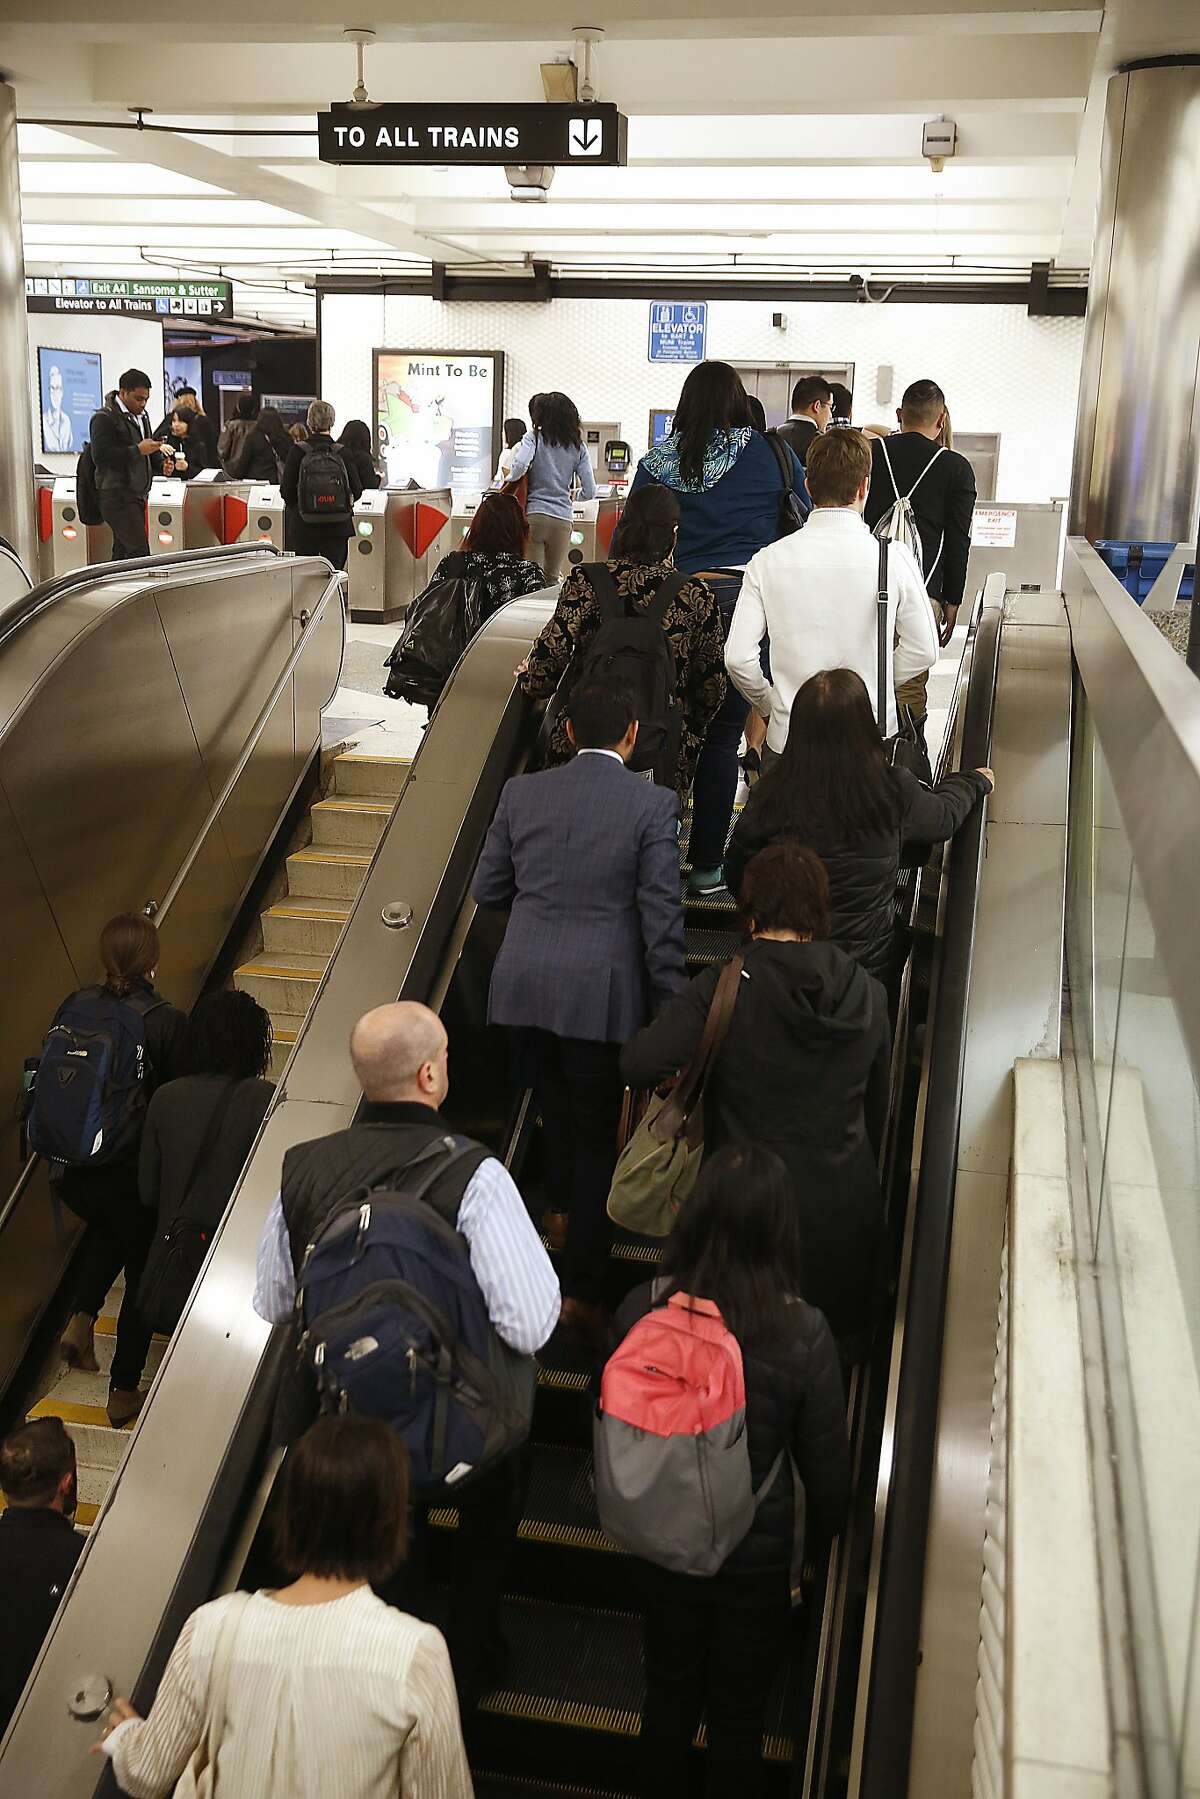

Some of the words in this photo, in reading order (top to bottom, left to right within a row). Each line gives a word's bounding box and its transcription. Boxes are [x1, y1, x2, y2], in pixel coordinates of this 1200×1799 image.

[333, 127, 365, 147] TO
[376, 127, 419, 147] ALL
[428, 127, 519, 148] TRAINS
[92, 283, 111, 294] Exit
[113, 284, 126, 294] A4
[133, 284, 175, 295] Sansome
[178, 285, 186, 295] &
[188, 285, 219, 296] Sutter
[55, 298, 93, 310] Elevator
[95, 299, 106, 310] to
[109, 298, 121, 310] All
[124, 299, 152, 311] Trains
[653, 323, 703, 334] ELEVATOR
[408, 363, 440, 376] Mint
[446, 364, 463, 377] To
[469, 365, 488, 377] Be
